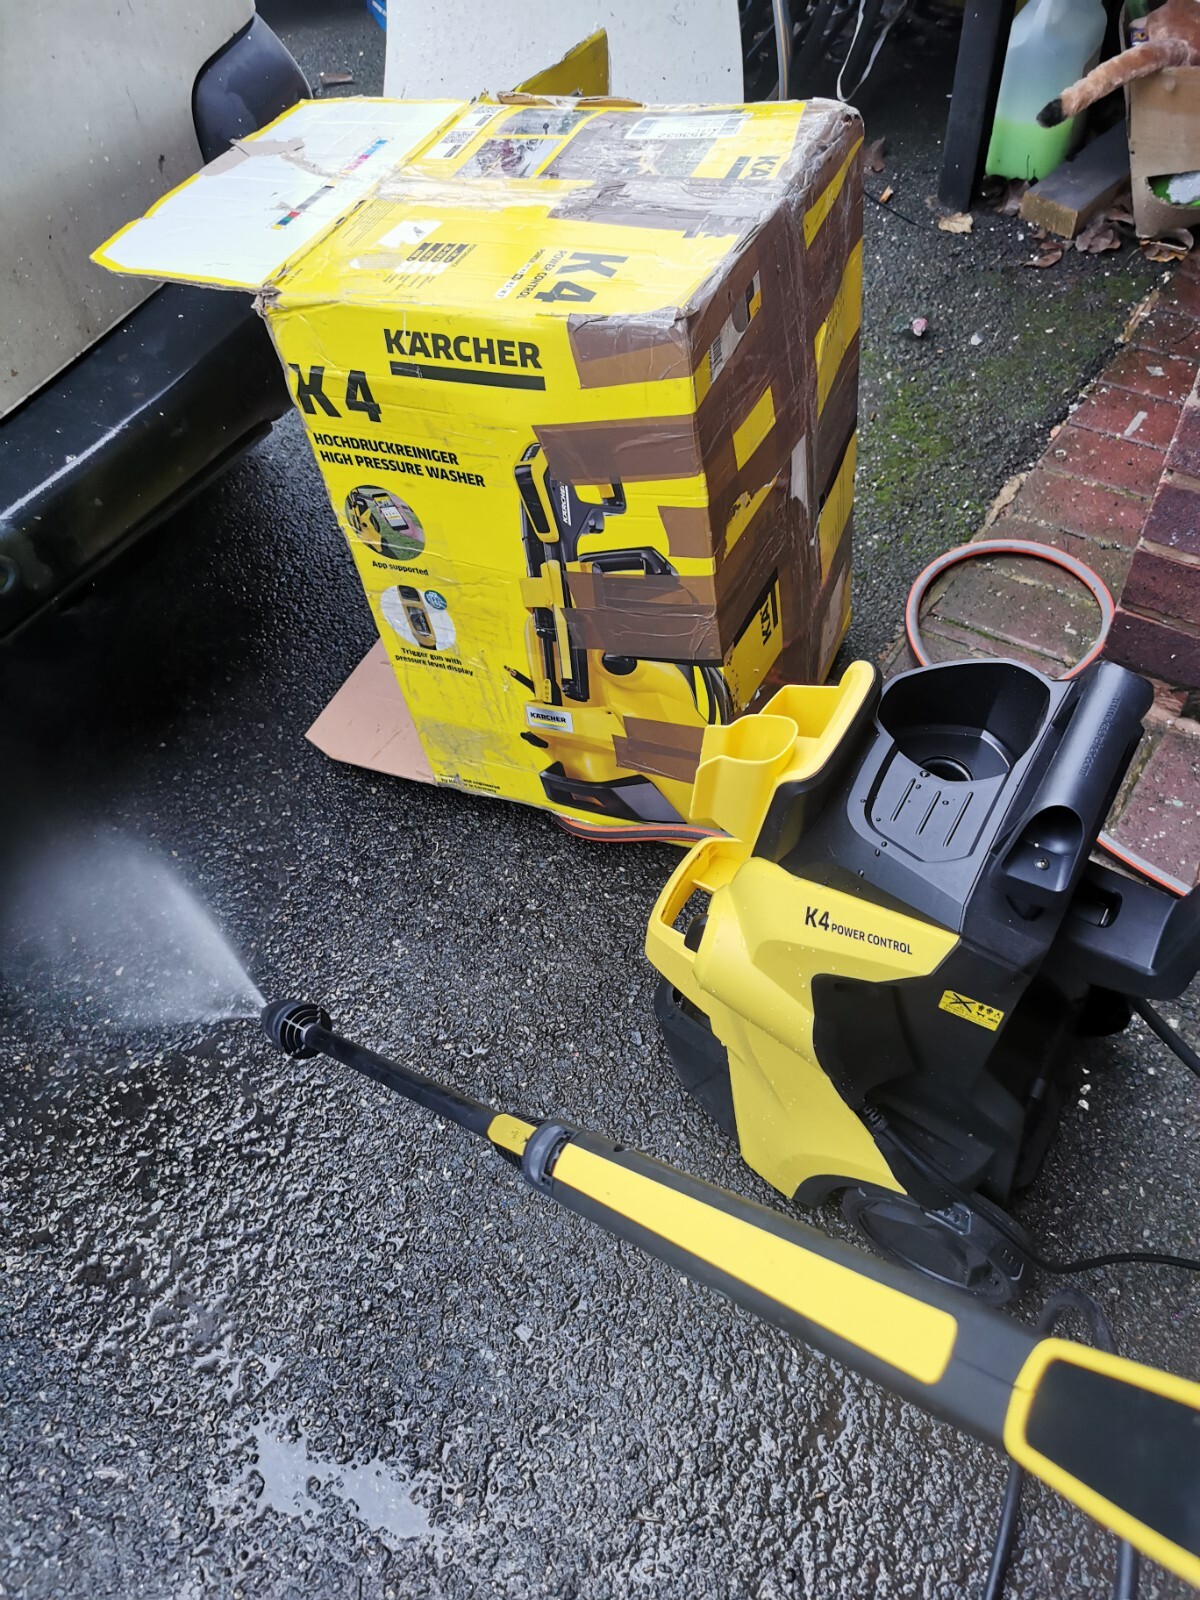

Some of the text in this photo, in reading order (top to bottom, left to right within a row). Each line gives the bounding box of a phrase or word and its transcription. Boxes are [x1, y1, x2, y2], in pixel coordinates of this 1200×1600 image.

[516, 271, 548, 299] CONTROL
[383, 328, 543, 369] KÄRCHER
[313, 432, 459, 466] HOCHDRUCKREINIGER
[319, 450, 486, 487] HIGH PRESSURE WASHER
[372, 560, 429, 576] App supported
[395, 654, 474, 677] pressure level display
[401, 647, 462, 666] Trigger gun with
[831, 923, 865, 941] POWER
[867, 933, 913, 955] CONTROL
